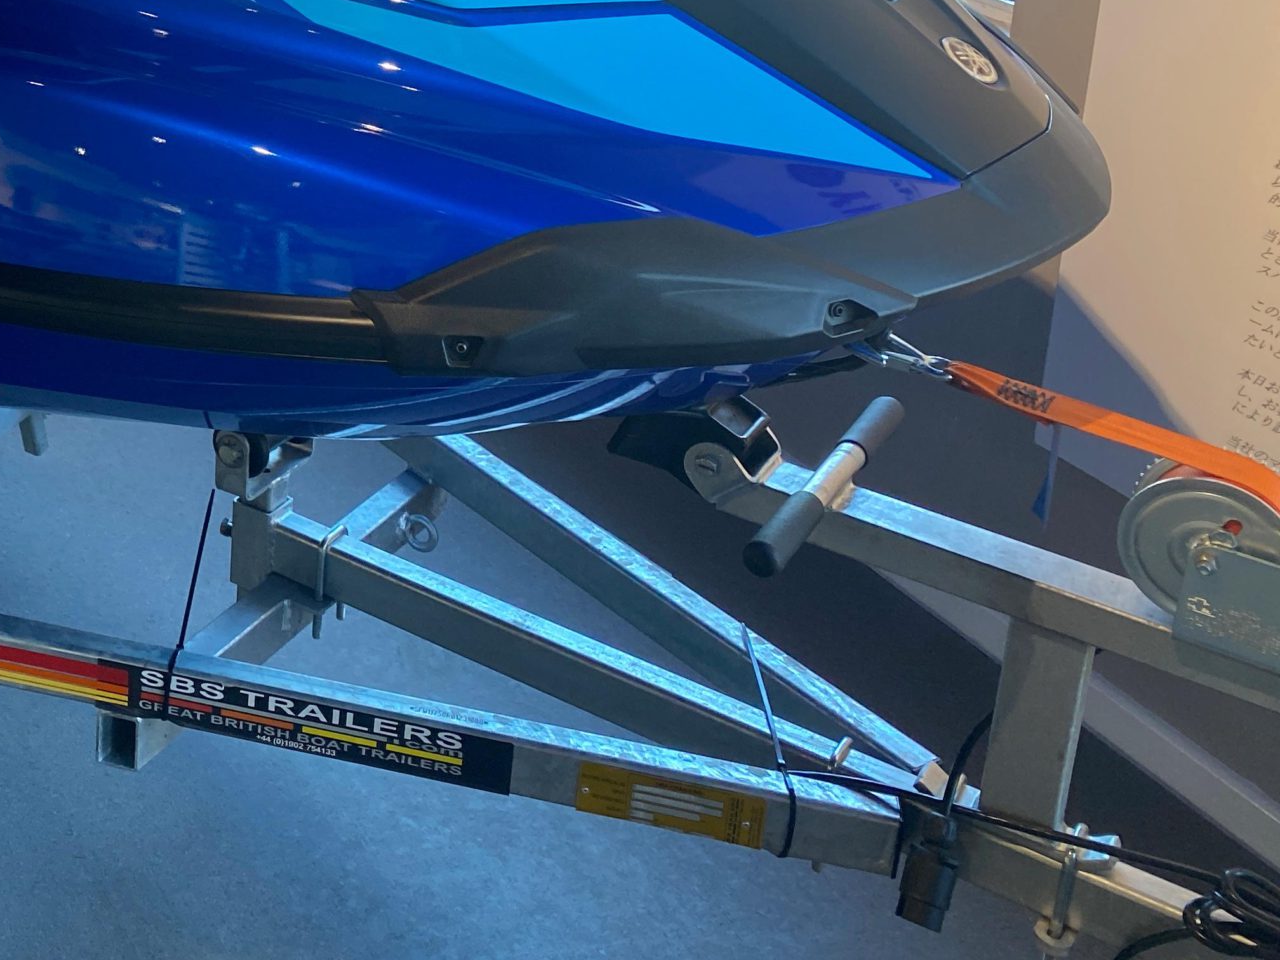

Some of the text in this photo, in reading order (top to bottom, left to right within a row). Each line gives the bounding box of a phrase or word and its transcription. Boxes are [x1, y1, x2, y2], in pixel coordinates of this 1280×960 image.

[140, 670, 225, 700] SBS
[239, 690, 463, 750] TRAILERS
[210, 714, 290, 740] BRITISH
[296, 733, 353, 752] BOAT
[358, 746, 463, 777] TRAILERS
